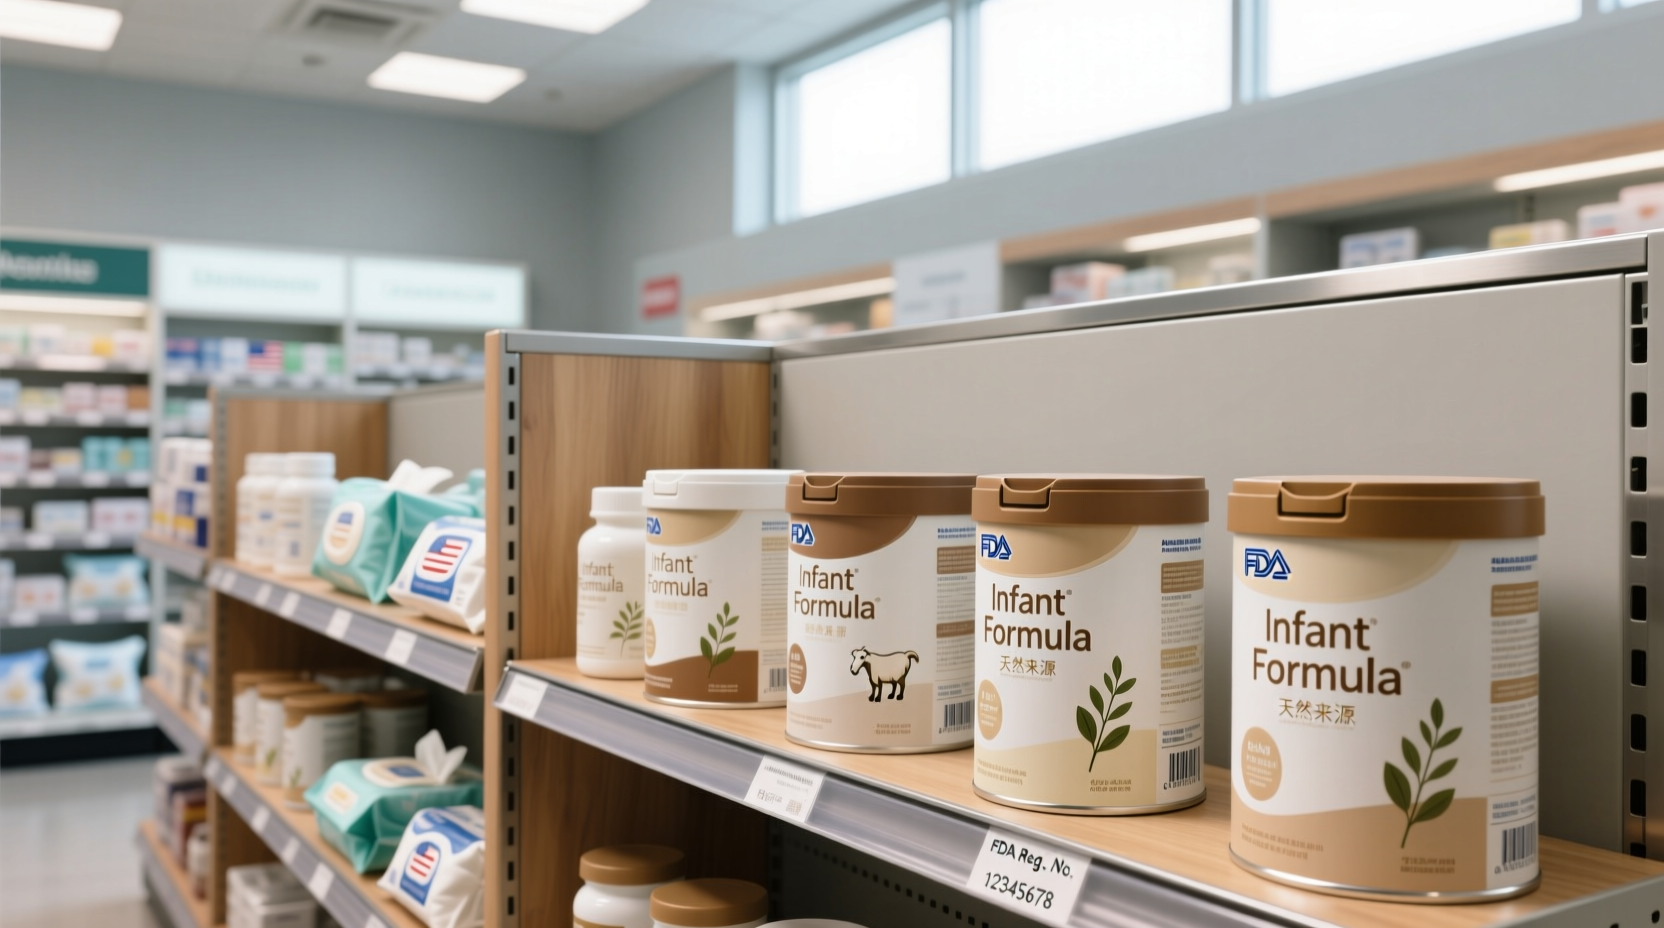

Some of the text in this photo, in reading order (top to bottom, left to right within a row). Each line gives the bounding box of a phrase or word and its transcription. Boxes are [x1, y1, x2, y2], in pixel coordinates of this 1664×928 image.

[791, 523, 814, 545] FDA
[981, 534, 1012, 560] FDA
[1245, 548, 1291, 580] FDA
[984, 615, 1091, 652] Formula
[990, 839, 1073, 879] FDA Reg. No.
[985, 872, 1054, 909] 12345678
